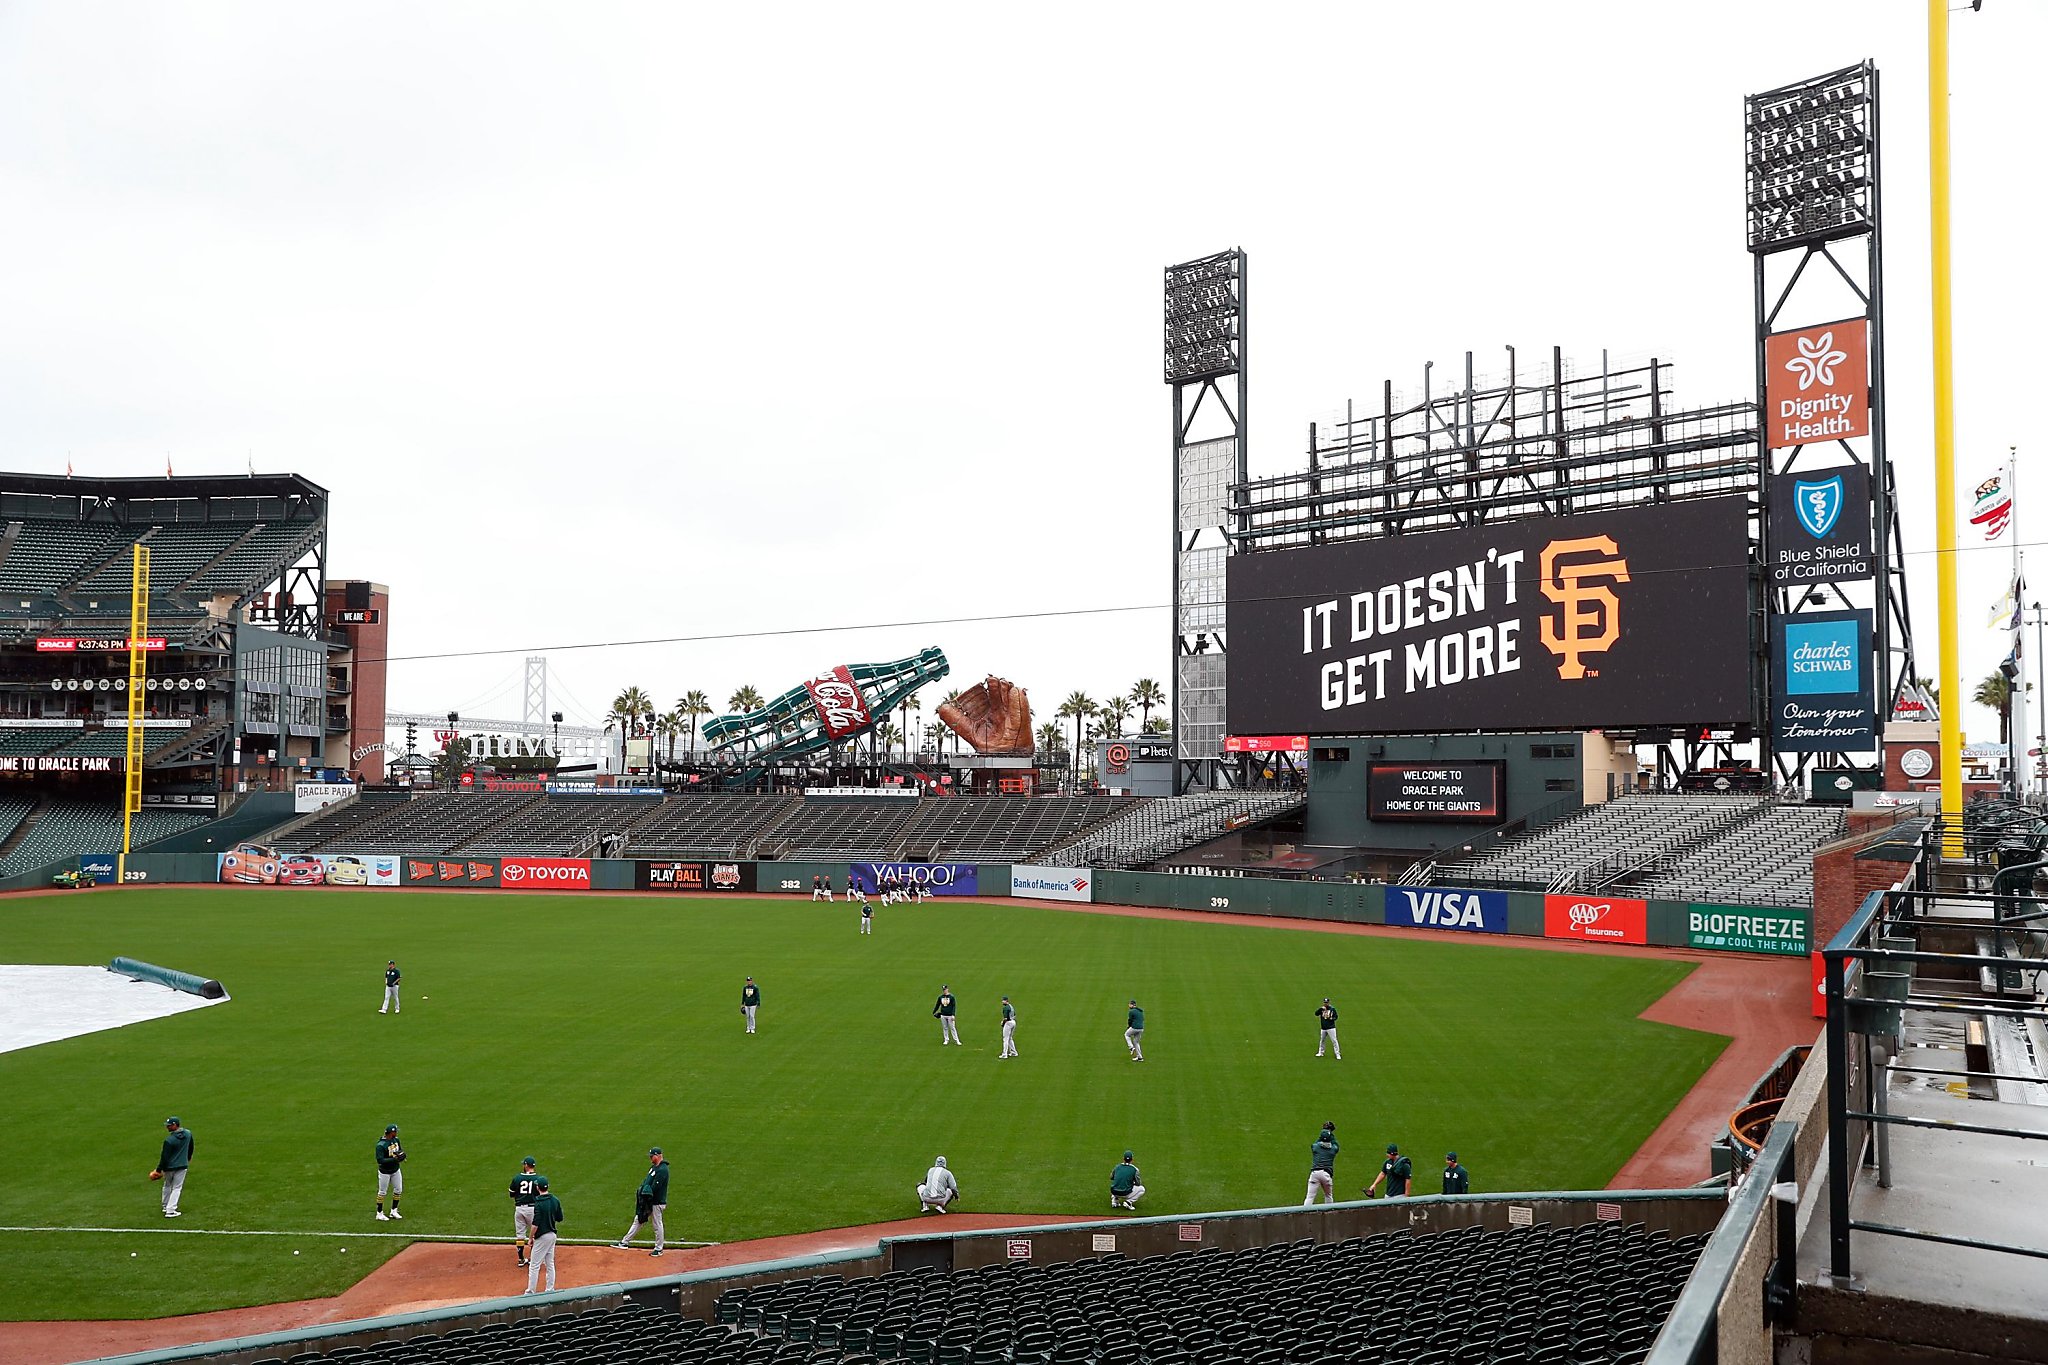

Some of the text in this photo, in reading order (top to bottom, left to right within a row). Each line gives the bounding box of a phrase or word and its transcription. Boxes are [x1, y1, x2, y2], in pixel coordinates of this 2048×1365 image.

[1781, 392, 1853, 420] Dignity
[1784, 415, 1849, 440] Health
[1780, 543, 1860, 563] Blue Shield
[1775, 560, 1866, 580] of California
[1302, 547, 1524, 655] IT DOESN'T
[344, 612, 353, 621] WE
[353, 612, 364, 621] ARE
[78, 640, 124, 649] 4:37:43 PM
[1793, 641, 1851, 660] charles
[1320, 618, 1523, 712] GET MORE
[1793, 660, 1852, 673] SCHWAB
[1586, 670, 1599, 678] TM
[1783, 703, 1865, 727] Own your
[1900, 710, 1920, 719] LIGHT
[468, 735, 616, 758] nuveen
[1260, 740, 1272, 748] $50
[1962, 748, 1988, 756] Coors
[22, 757, 36, 770] TO
[38, 757, 79, 770] ORACLE
[82, 757, 110, 770] PARK
[1403, 770, 1462, 780] WELCOME TO
[297, 786, 353, 798] ORACLE PARK
[501, 782, 541, 792] TOYOTA
[1402, 785, 1464, 795] ORACLE PARK
[1386, 800, 1481, 811] HOME OF THE GIANTS
[83, 863, 112, 872] Alaska
[527, 866, 589, 881] TOYOTA
[124, 871, 147, 880] 339
[650, 868, 702, 882] PLAY BALL
[712, 873, 740, 884] GIANTS
[871, 864, 956, 886] YAHOO!
[780, 880, 801, 889] 382
[1013, 877, 1068, 891] Bank of America
[1210, 897, 1229, 908] 399
[1402, 891, 1484, 928] VISA
[1571, 904, 1597, 924] AAA
[1585, 926, 1624, 937] Insurance
[1728, 937, 1805, 952] COOL THE PAIN
[520, 1180, 533, 1194] 21
